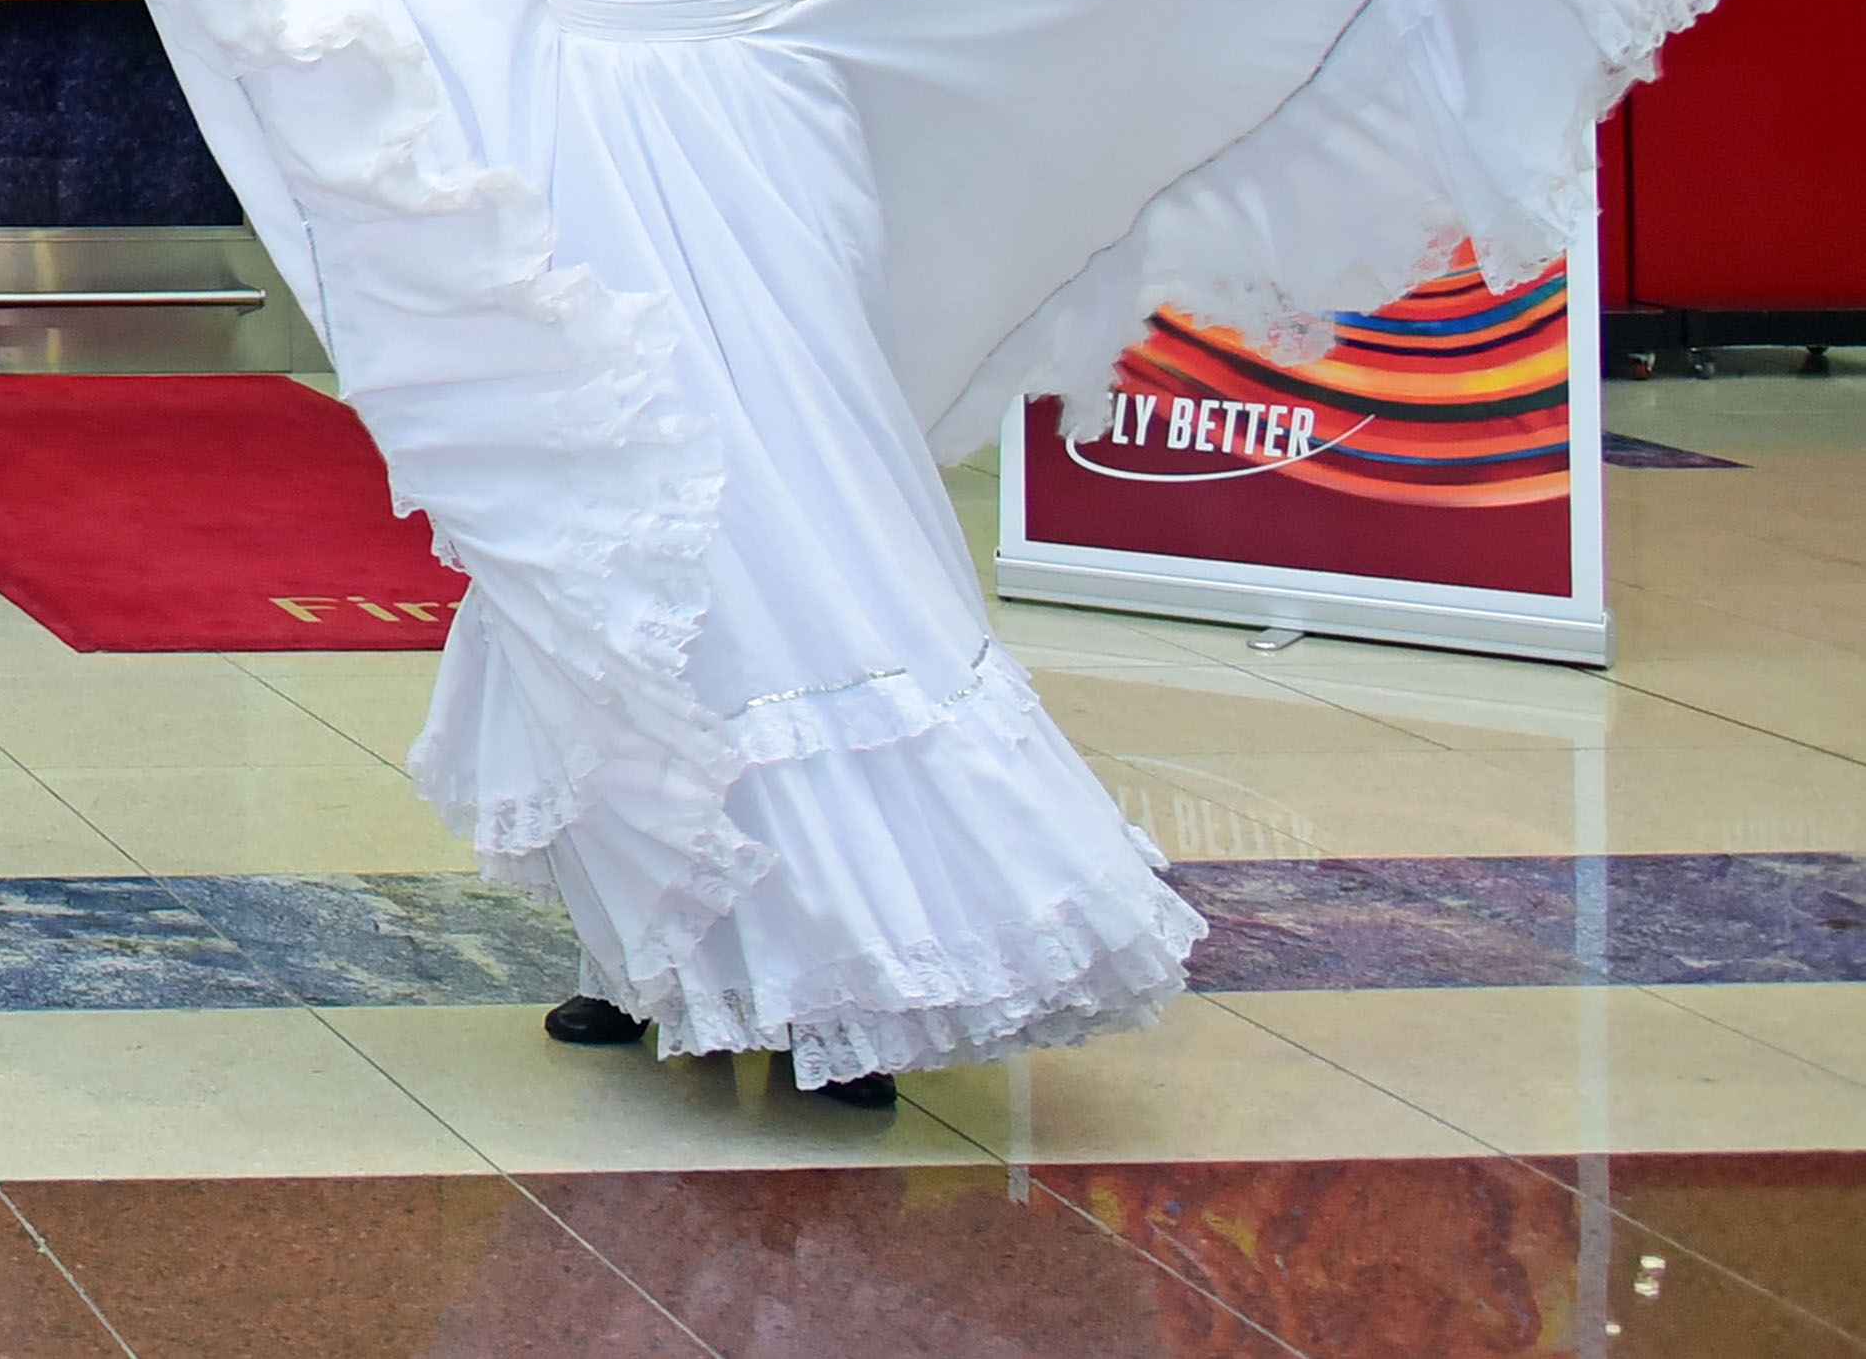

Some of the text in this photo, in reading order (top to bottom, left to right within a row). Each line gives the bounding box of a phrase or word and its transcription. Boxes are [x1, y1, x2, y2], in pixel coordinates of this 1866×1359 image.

[1111, 393, 1315, 459] LY BETTER
[269, 596, 461, 622] Fir
